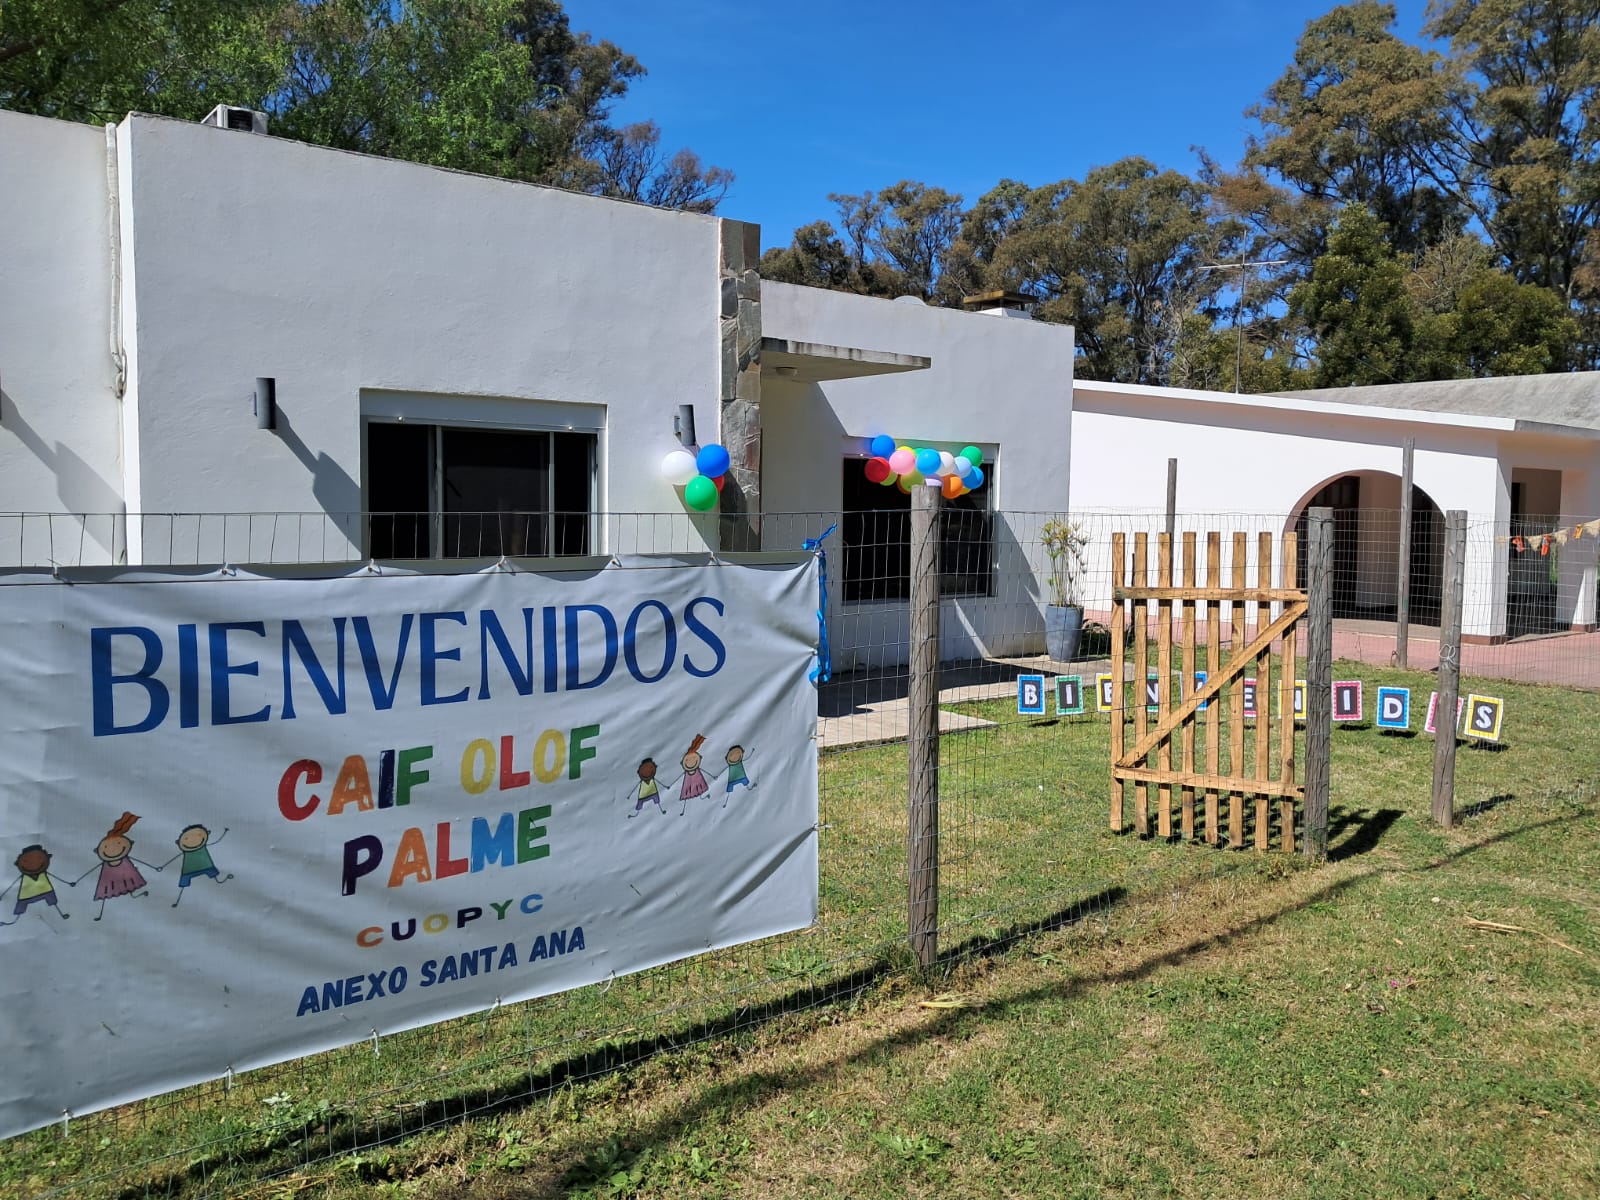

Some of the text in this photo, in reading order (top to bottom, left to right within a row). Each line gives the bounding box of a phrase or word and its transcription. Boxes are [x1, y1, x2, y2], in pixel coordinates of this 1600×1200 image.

[91, 597, 726, 737] BIENVENIDOS
[278, 724, 600, 821] CAIF OLOF
[342, 805, 552, 896] PALME
[296, 926, 586, 1017] ANEXO SANTA ANA
